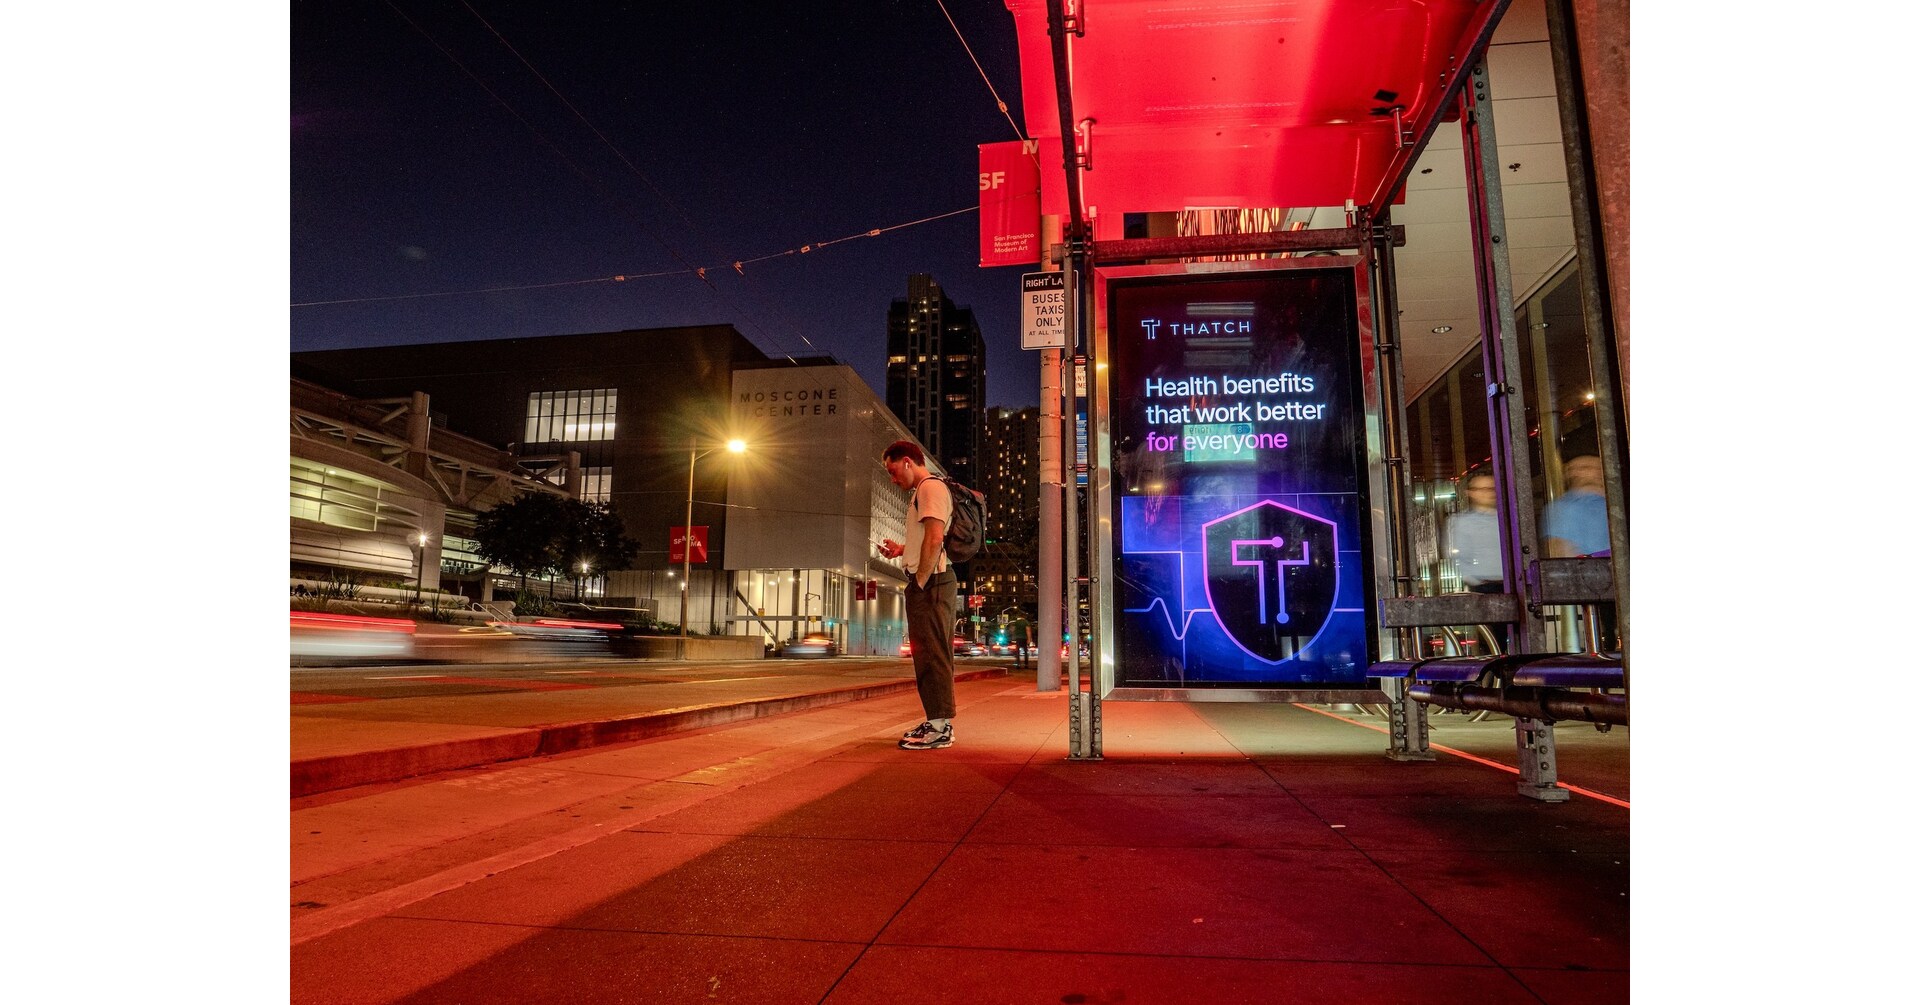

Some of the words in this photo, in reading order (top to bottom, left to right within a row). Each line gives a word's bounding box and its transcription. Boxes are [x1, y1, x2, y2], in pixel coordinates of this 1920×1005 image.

[979, 171, 1006, 191] SF
[1006, 232, 1034, 240] Francisco
[994, 240, 1020, 248] Museum
[1025, 278, 1049, 288] RIGHT
[1051, 277, 1064, 286] LA
[1035, 304, 1065, 316] TAXIS
[1035, 316, 1063, 328] ONLY
[1170, 320, 1251, 336] THATCH
[1145, 376, 1218, 398] Health
[1223, 372, 1314, 396] benefits
[740, 388, 838, 403] MOSCONE
[755, 404, 837, 418] CENTER
[1145, 404, 1191, 425] that
[1195, 402, 1253, 424] work
[1256, 401, 1326, 421] better
[1146, 431, 1178, 452] for
[1182, 432, 1289, 455] everyone
